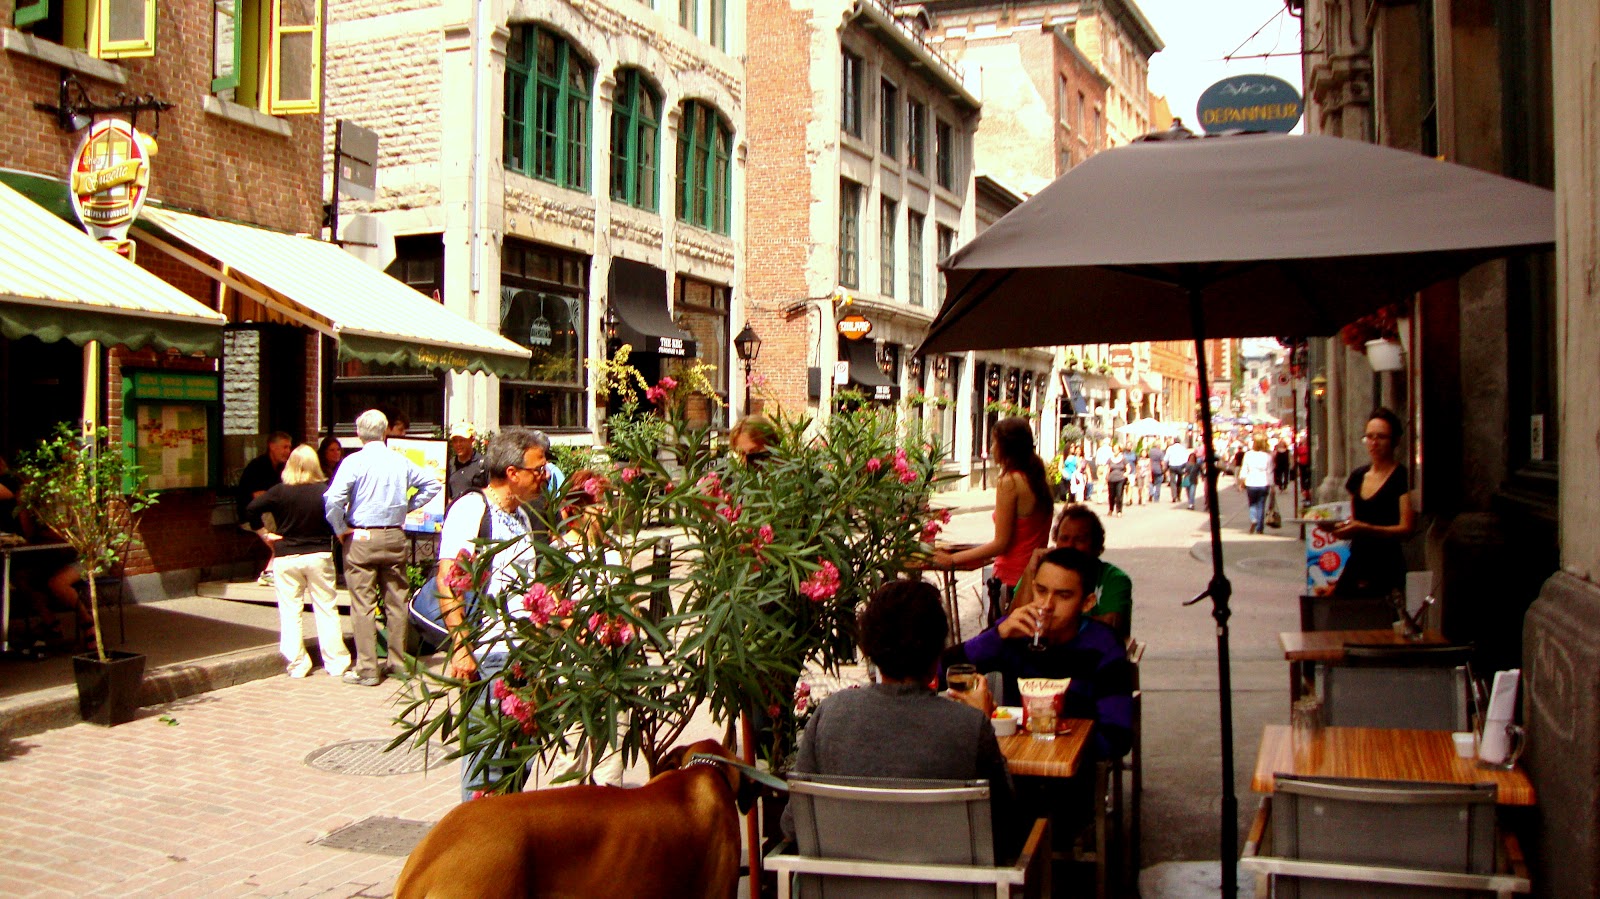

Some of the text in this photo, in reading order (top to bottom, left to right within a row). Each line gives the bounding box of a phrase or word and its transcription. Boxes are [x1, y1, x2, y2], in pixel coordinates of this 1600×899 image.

[85, 165, 128, 193] Suzette
[660, 337, 683, 349] THE KEG
